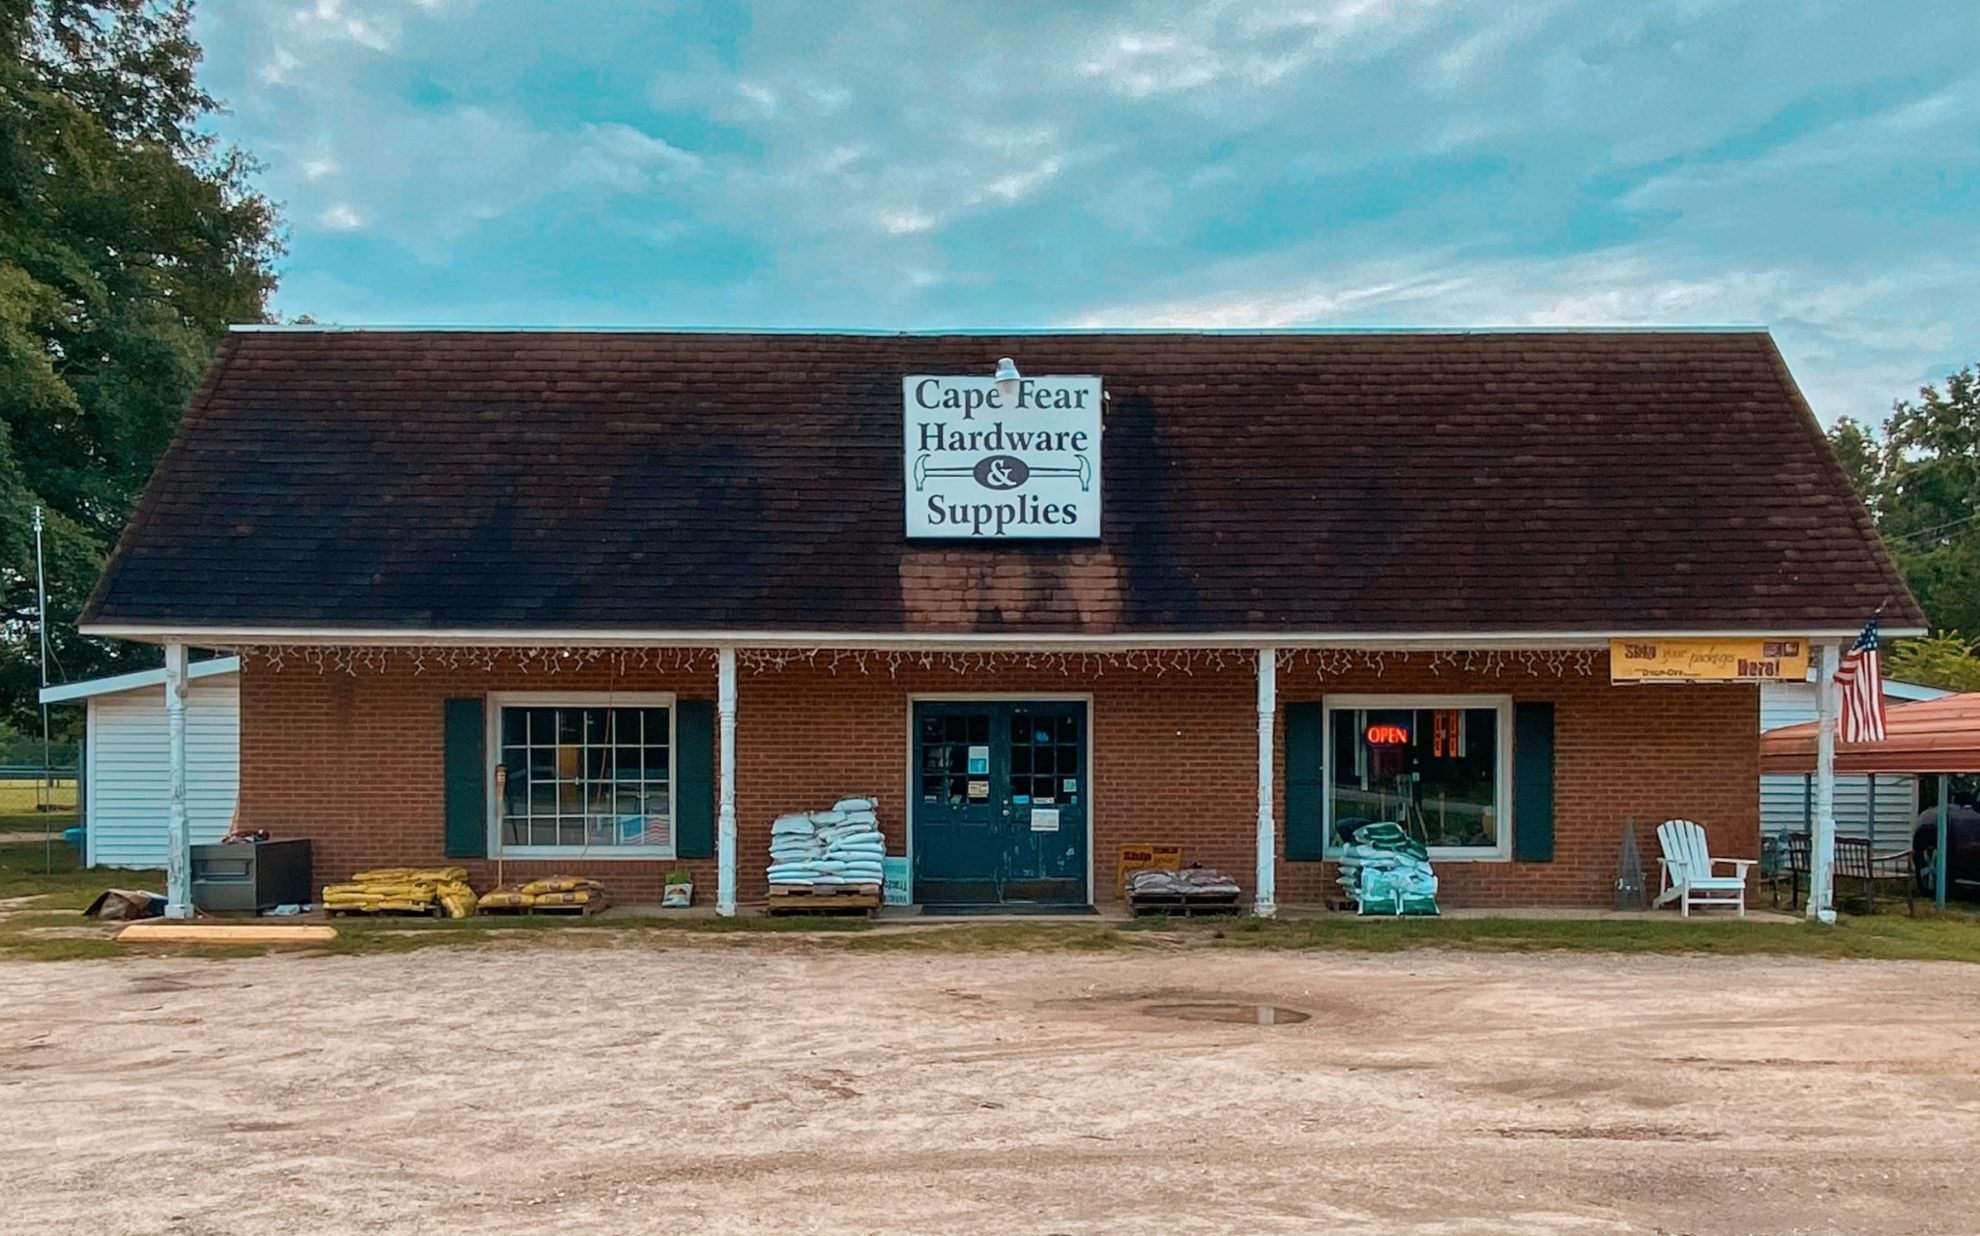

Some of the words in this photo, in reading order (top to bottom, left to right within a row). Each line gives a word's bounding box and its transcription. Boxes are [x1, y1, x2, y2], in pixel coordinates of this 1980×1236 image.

[915, 378, 1003, 420] Cape
[1015, 379, 1089, 409] Fear
[917, 421, 1089, 452] Hardware
[986, 459, 1017, 486] &
[927, 493, 1078, 536] Supplies
[1625, 644, 1657, 660] Ship
[1737, 658, 1780, 677] Here!
[1367, 727, 1408, 744] OPEN
